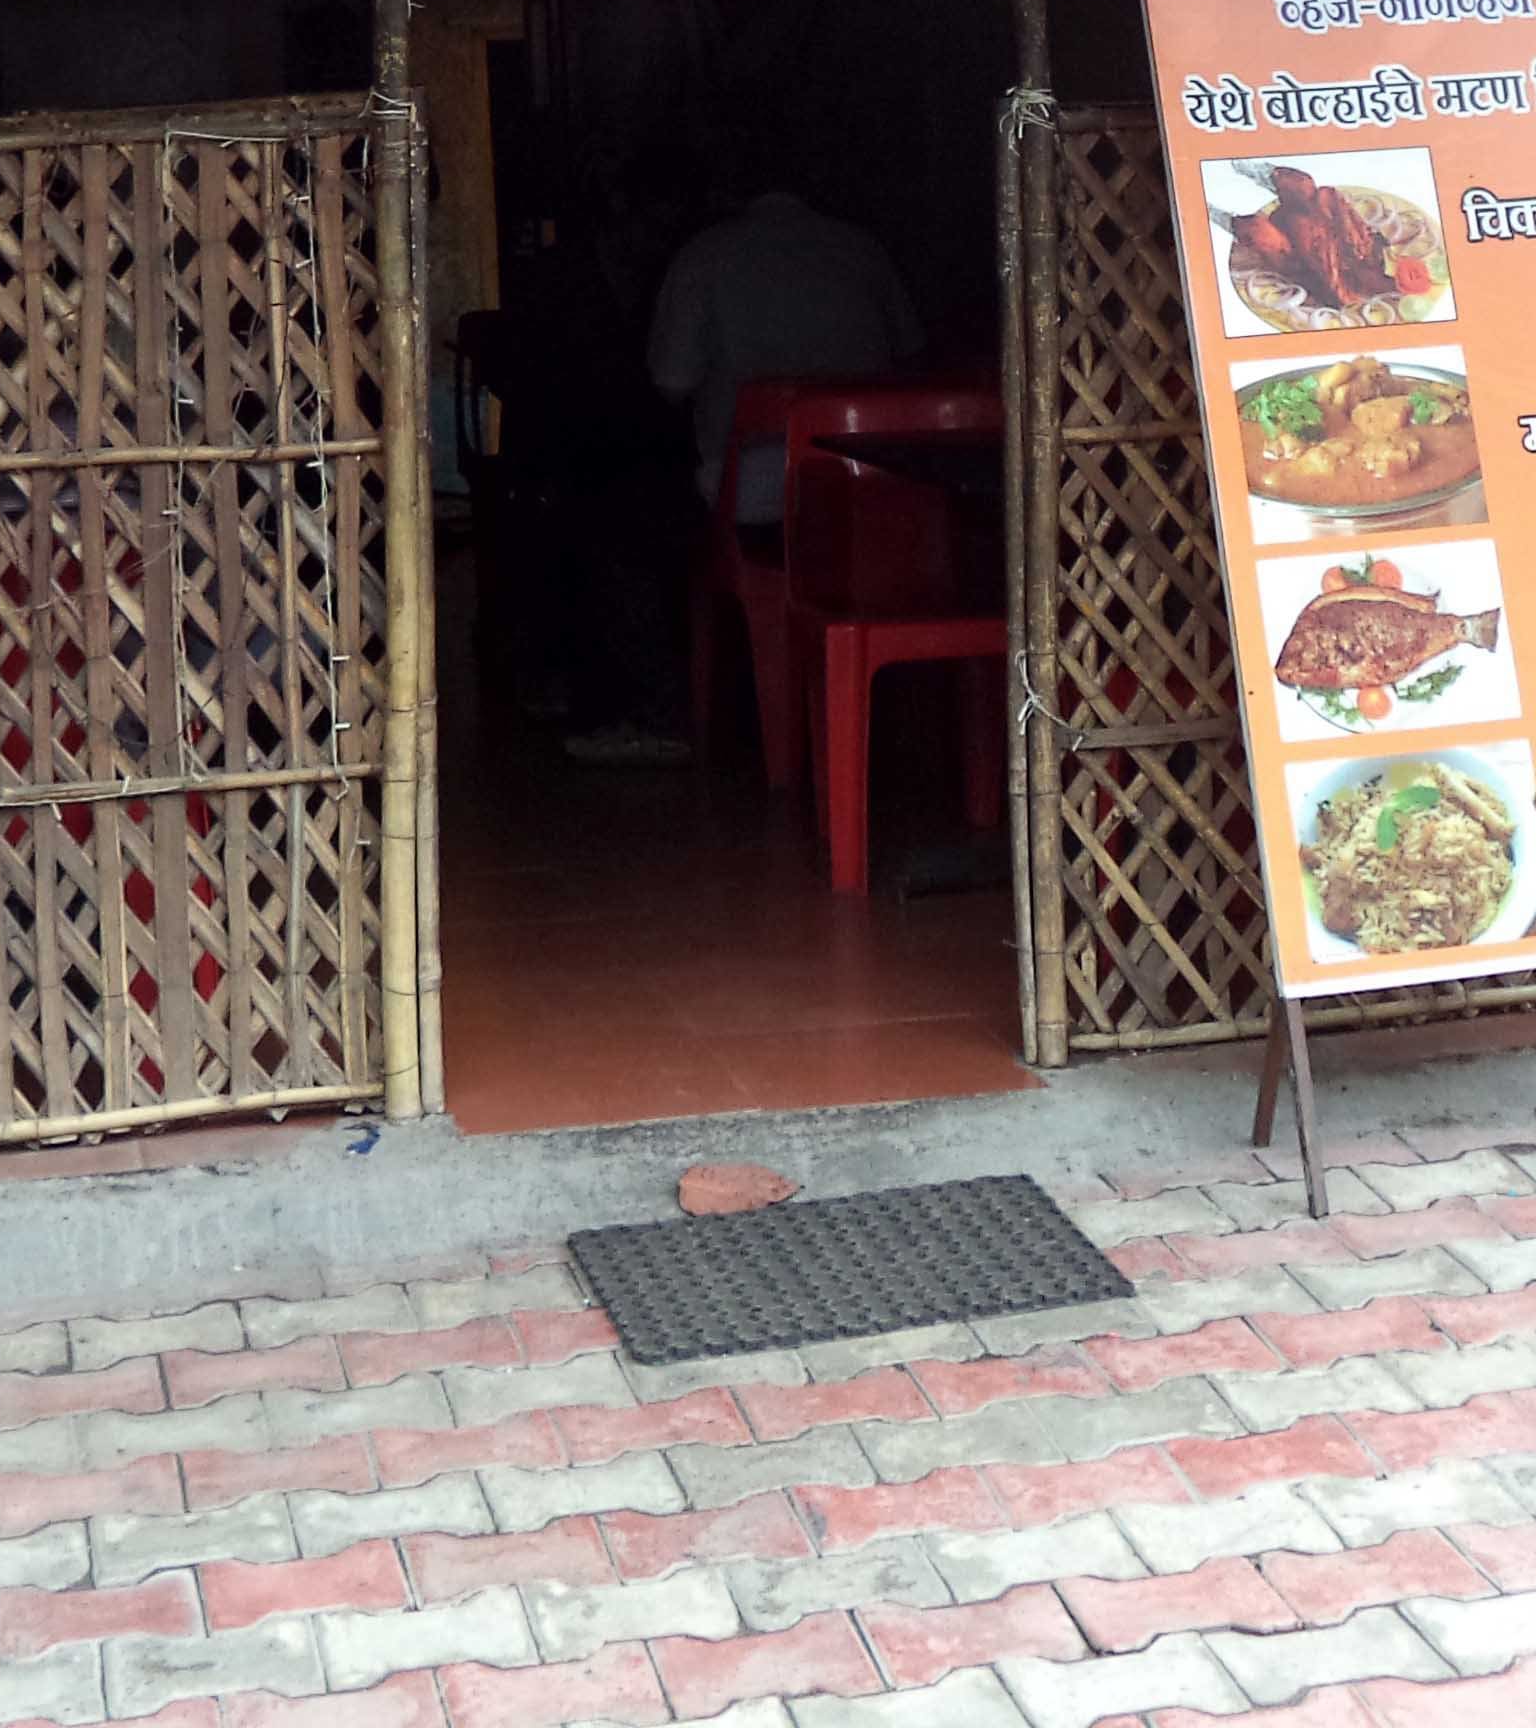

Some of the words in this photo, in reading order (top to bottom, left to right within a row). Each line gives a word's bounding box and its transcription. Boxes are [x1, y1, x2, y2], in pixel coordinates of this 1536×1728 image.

[1183, 77, 1255, 131] येथे
[1262, 66, 1428, 127] बोल्हाईचे
[1431, 69, 1525, 117] मटण
